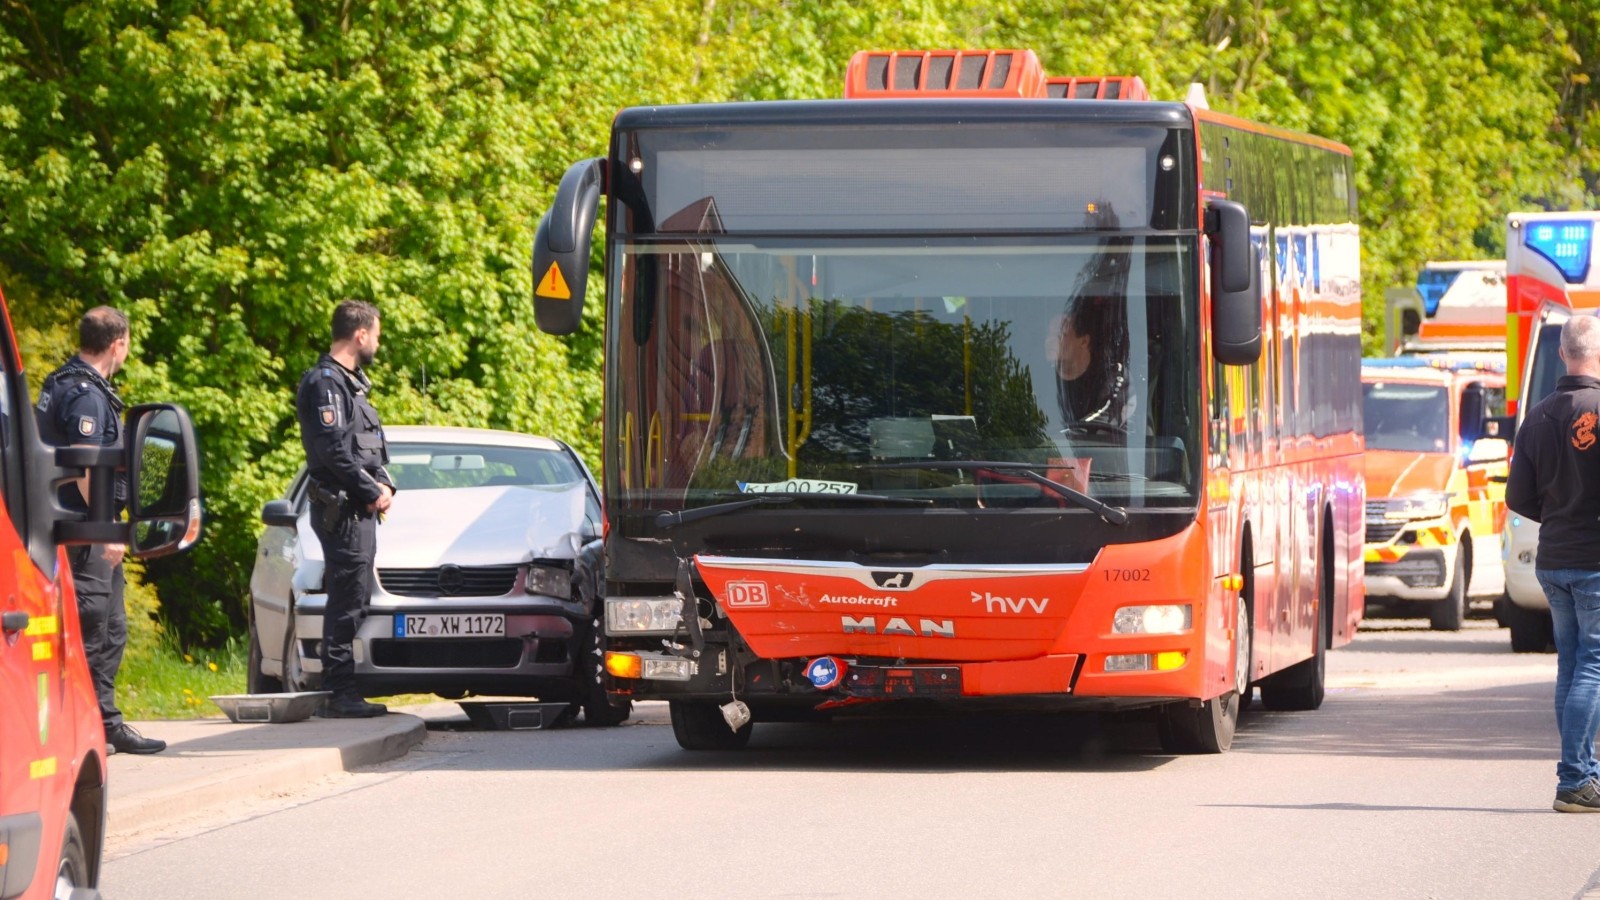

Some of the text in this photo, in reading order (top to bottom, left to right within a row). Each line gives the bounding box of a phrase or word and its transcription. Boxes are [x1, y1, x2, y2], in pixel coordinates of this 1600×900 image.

[1104, 569, 1151, 582] 17002
[732, 585, 764, 603] DB
[819, 593, 898, 607] Autokraft
[406, 617, 427, 634] RZ
[440, 616, 460, 634] XW
[465, 616, 503, 634] 1172
[841, 616, 955, 638] MAN
